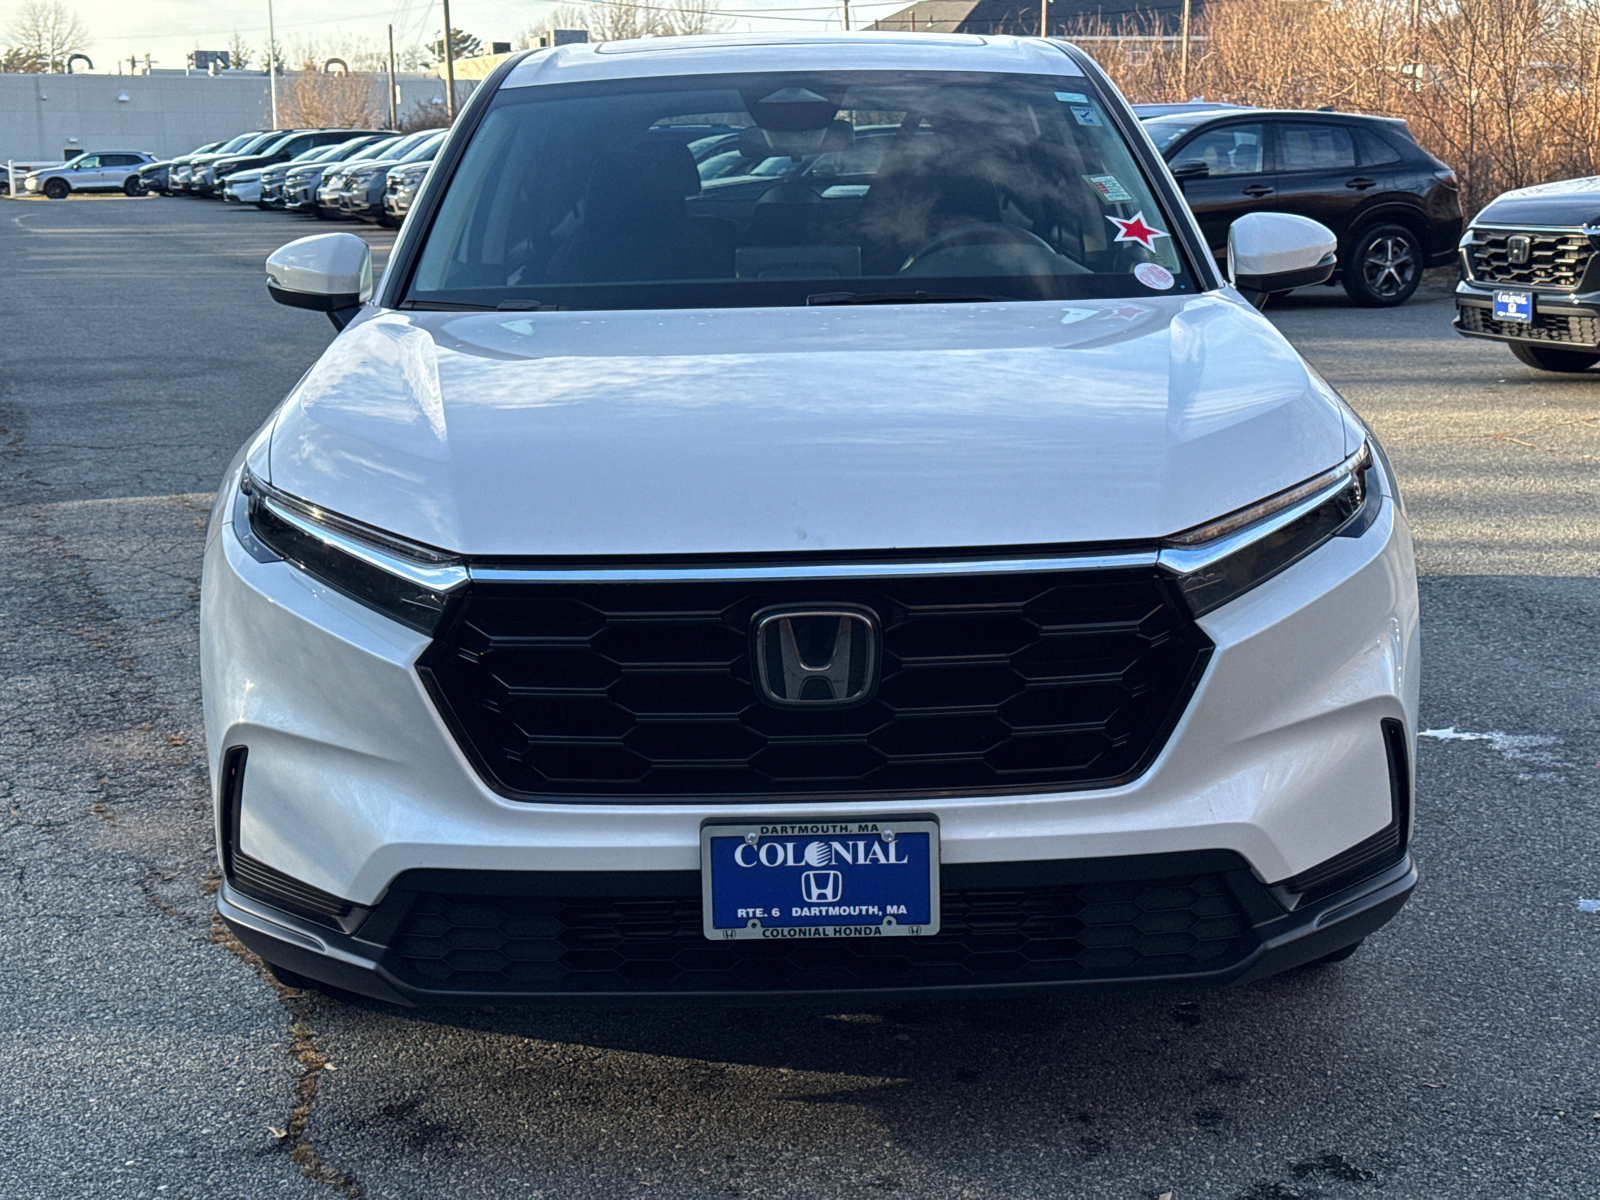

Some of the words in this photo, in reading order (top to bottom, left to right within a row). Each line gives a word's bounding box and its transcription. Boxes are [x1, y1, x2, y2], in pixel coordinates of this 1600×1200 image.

[858, 824, 879, 833] MA
[737, 908, 768, 918] RTE.
[771, 908, 781, 917] 6
[791, 905, 883, 917] DARTMOUTH,
[886, 905, 908, 914] MA
[762, 927, 830, 938] COLONIAL
[833, 926, 882, 937] HONDA
